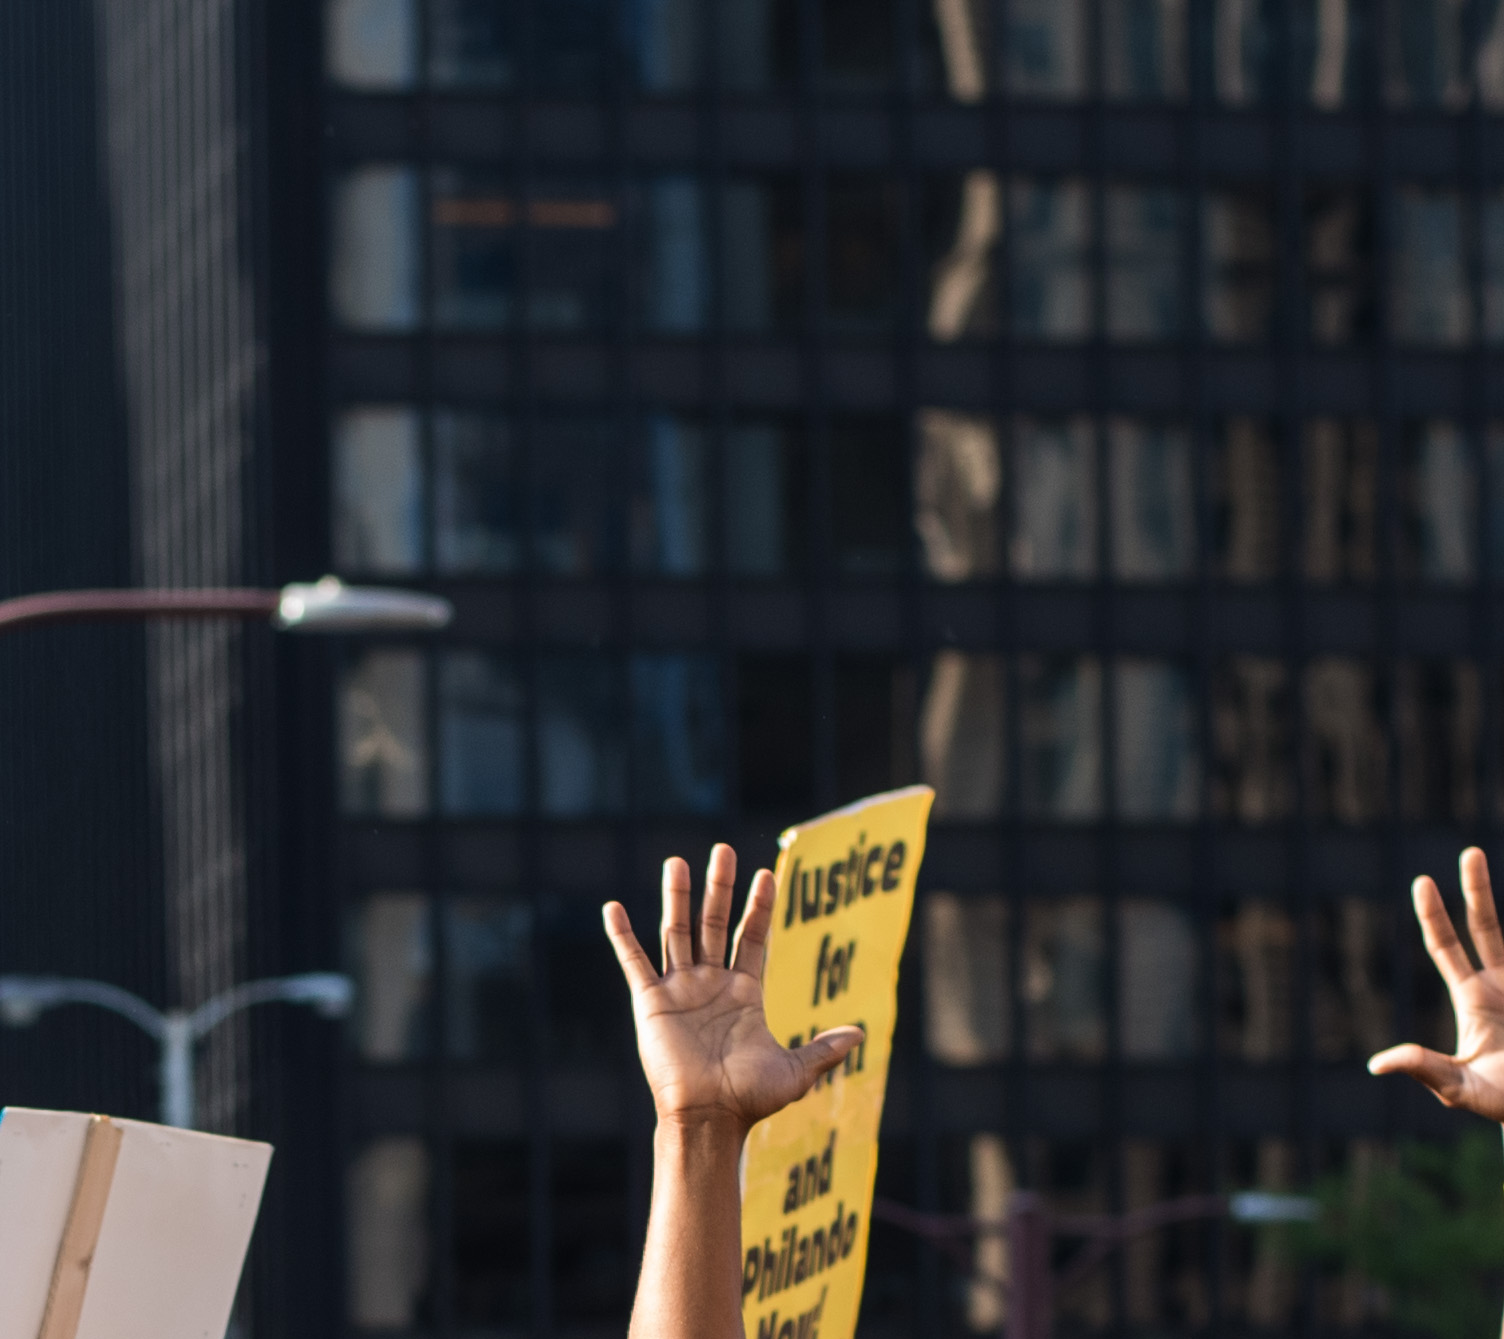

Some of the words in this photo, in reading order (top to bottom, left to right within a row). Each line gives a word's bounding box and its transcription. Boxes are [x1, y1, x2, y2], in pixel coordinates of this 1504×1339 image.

[784, 832, 907, 929] Justice
[812, 933, 856, 1008] for
[783, 1129, 837, 1216] and
[742, 1200, 857, 1309] Philando
